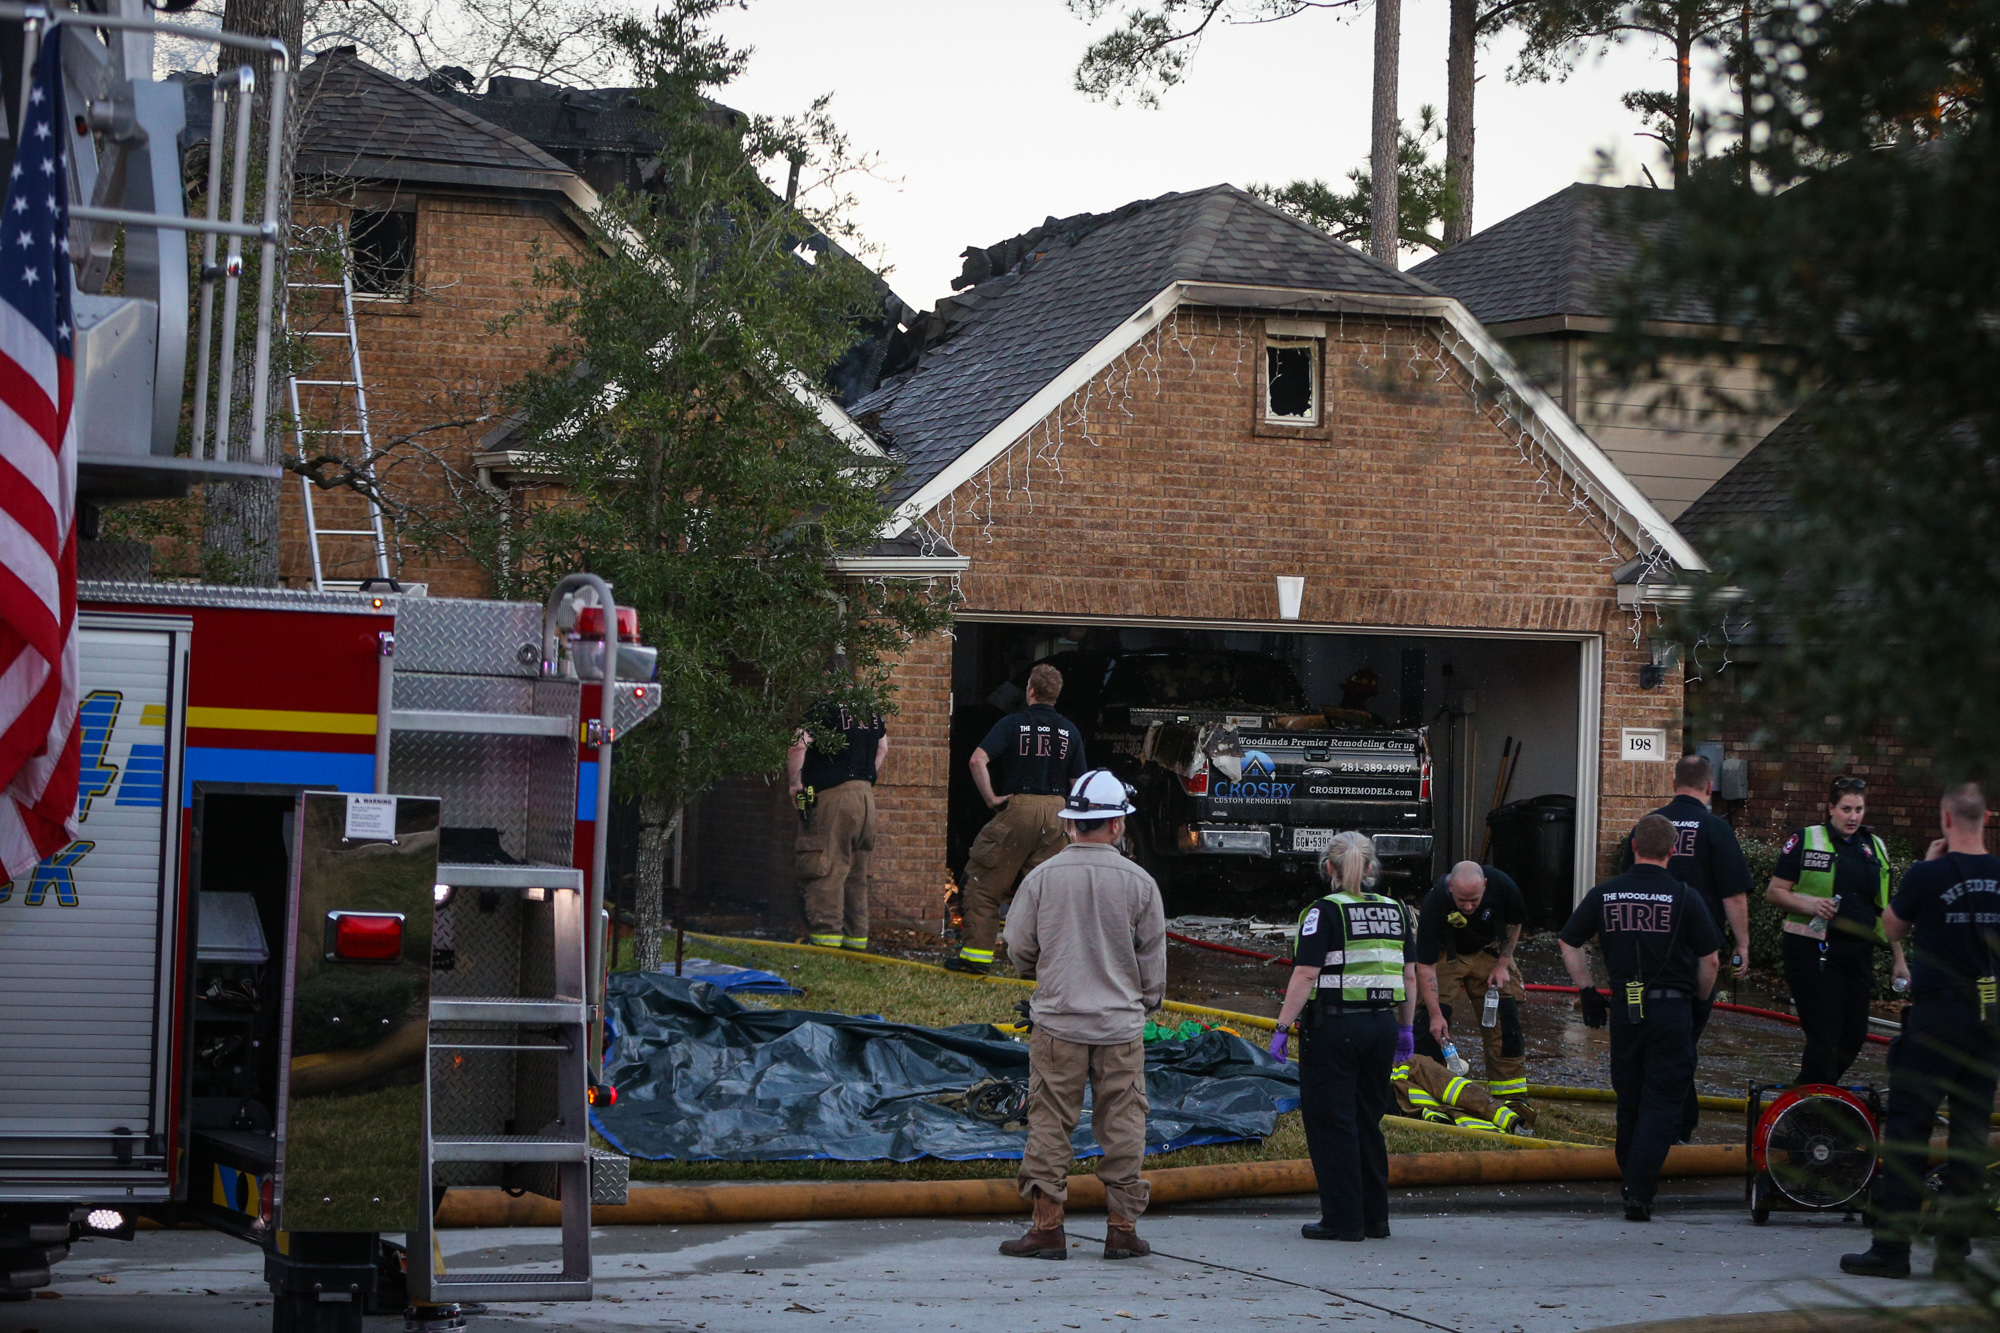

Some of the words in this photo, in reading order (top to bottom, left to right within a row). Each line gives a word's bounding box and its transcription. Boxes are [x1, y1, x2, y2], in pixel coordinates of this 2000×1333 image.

[1019, 733, 1069, 760] FRE
[1238, 737, 1288, 746] Woodlands
[1291, 738, 1328, 747] Premier
[1331, 739, 1385, 749] Remodeling
[1629, 738, 1652, 750] 198
[1340, 763, 1412, 773] 281-389-4987
[1214, 781, 1296, 799] CROSBY
[1309, 785, 1413, 796] CROSBYREMODELS.com
[1671, 820, 1700, 829] DLANDS
[1804, 852, 1831, 861] MCHD
[1803, 860, 1829, 868] EMS
[1603, 893, 1617, 902] THE
[1618, 892, 1673, 903] WOODLANDS
[1348, 907, 1400, 922] MCHD
[1604, 902, 1672, 933] FIRE
[1351, 922, 1402, 936] EMS
